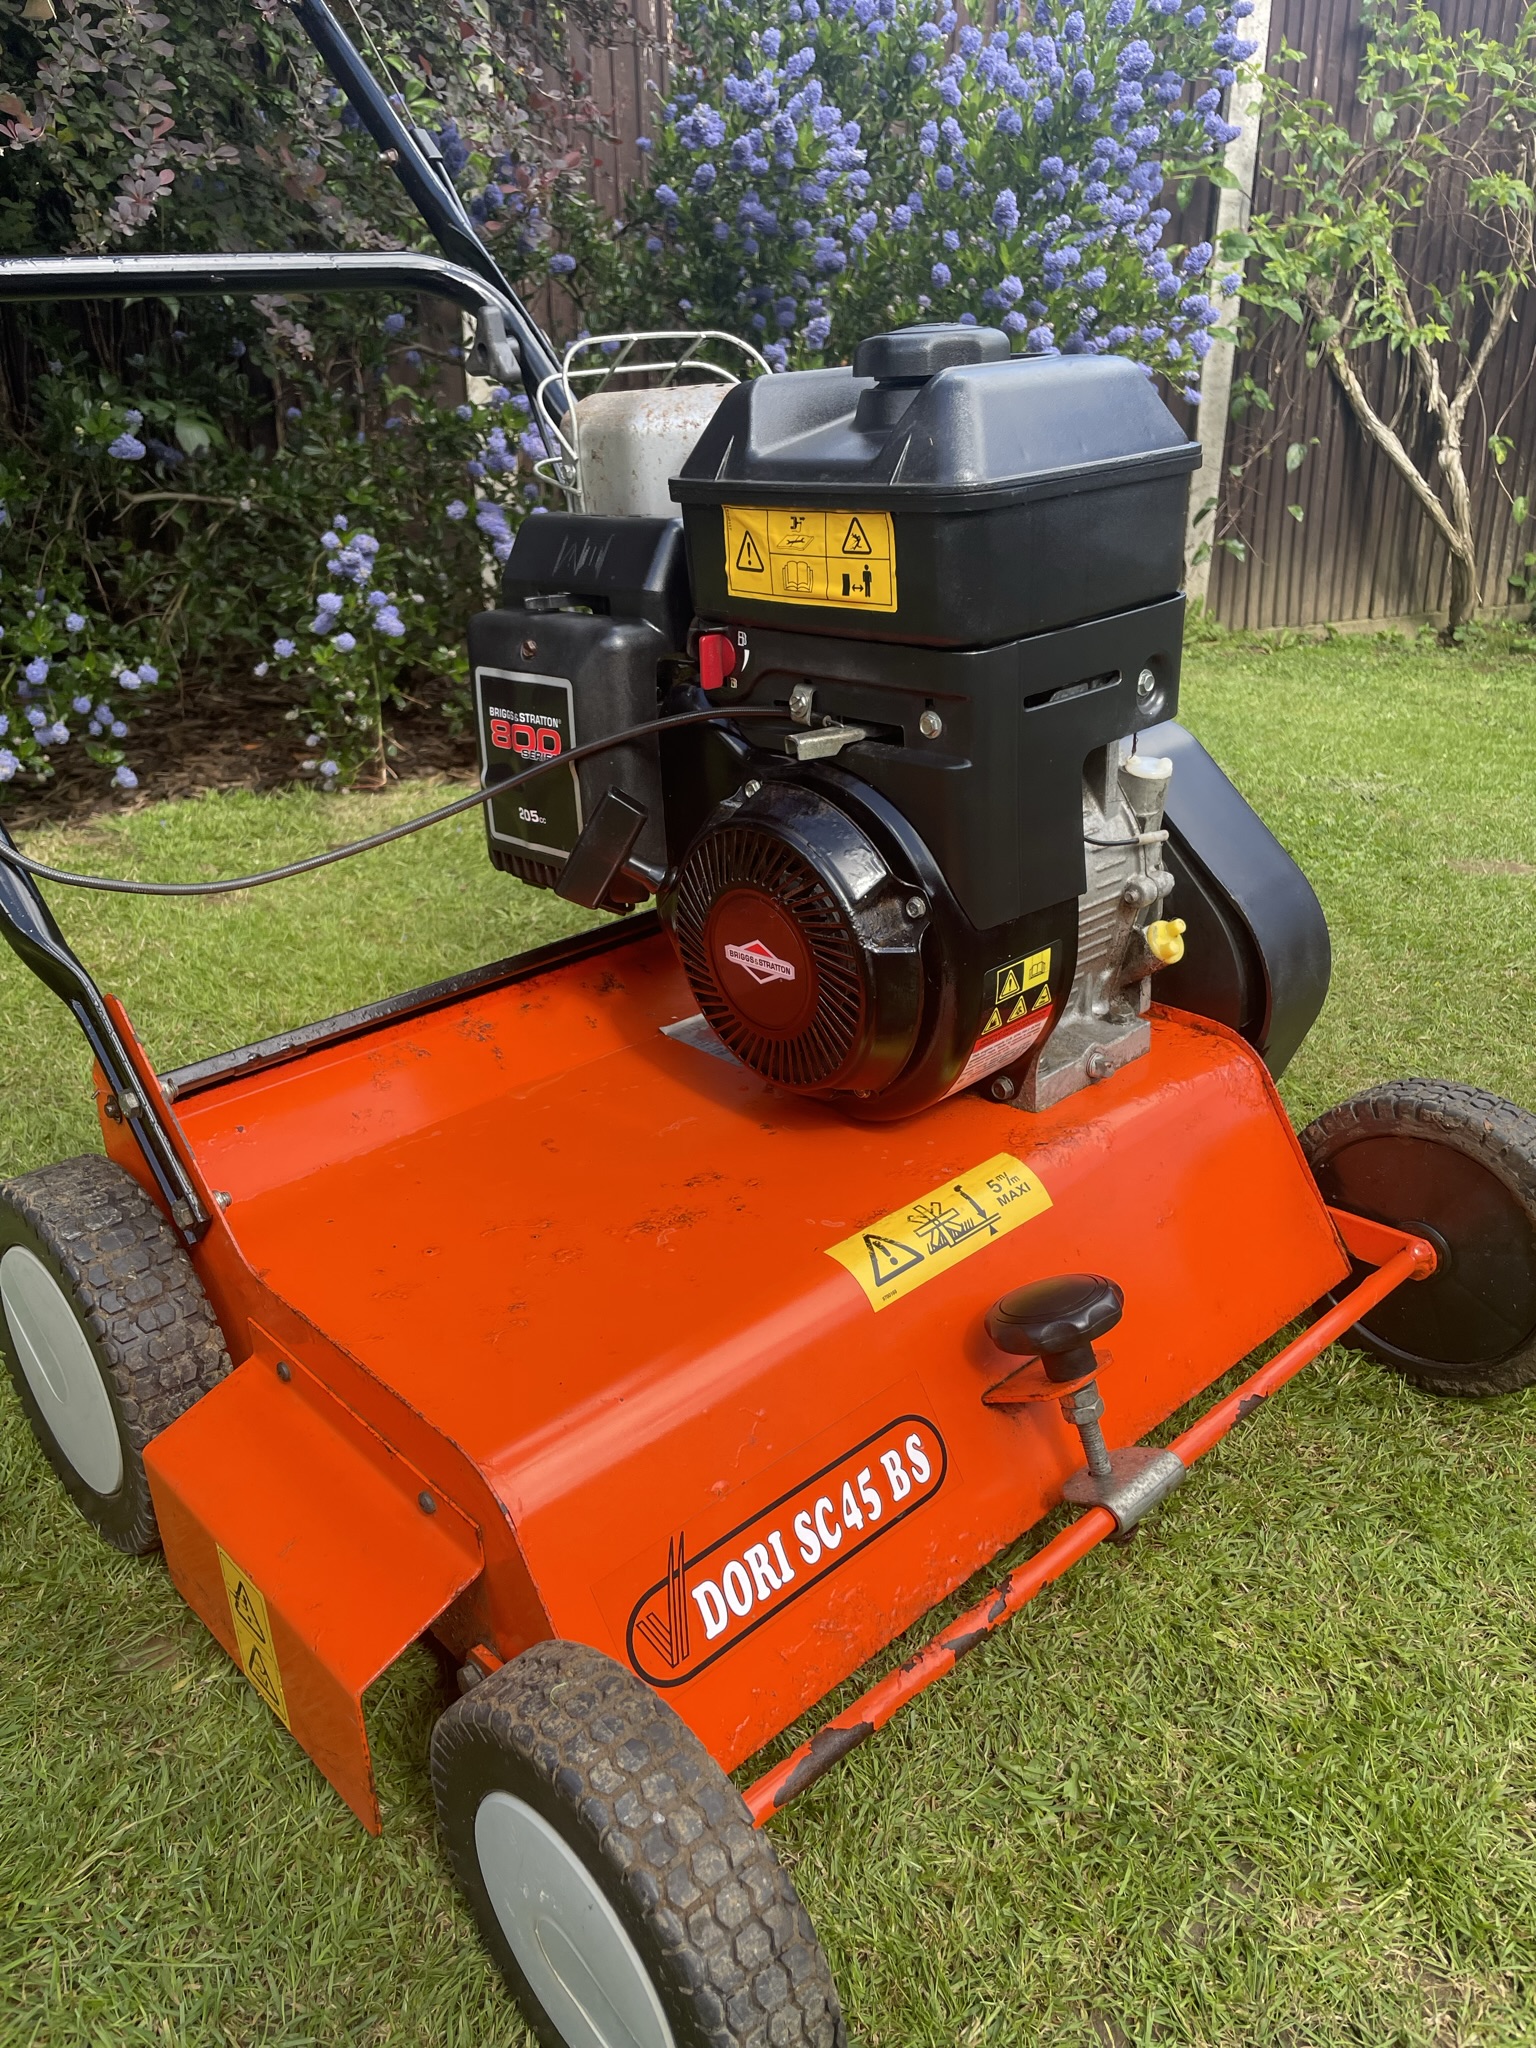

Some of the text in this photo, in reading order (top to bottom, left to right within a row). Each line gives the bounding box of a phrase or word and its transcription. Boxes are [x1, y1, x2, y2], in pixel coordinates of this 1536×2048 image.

[490, 719, 561, 756] 800
[521, 749, 558, 761] SERIE
[996, 1181, 1031, 1207] MAXI
[691, 1433, 931, 1640] DORI SC45 BS
